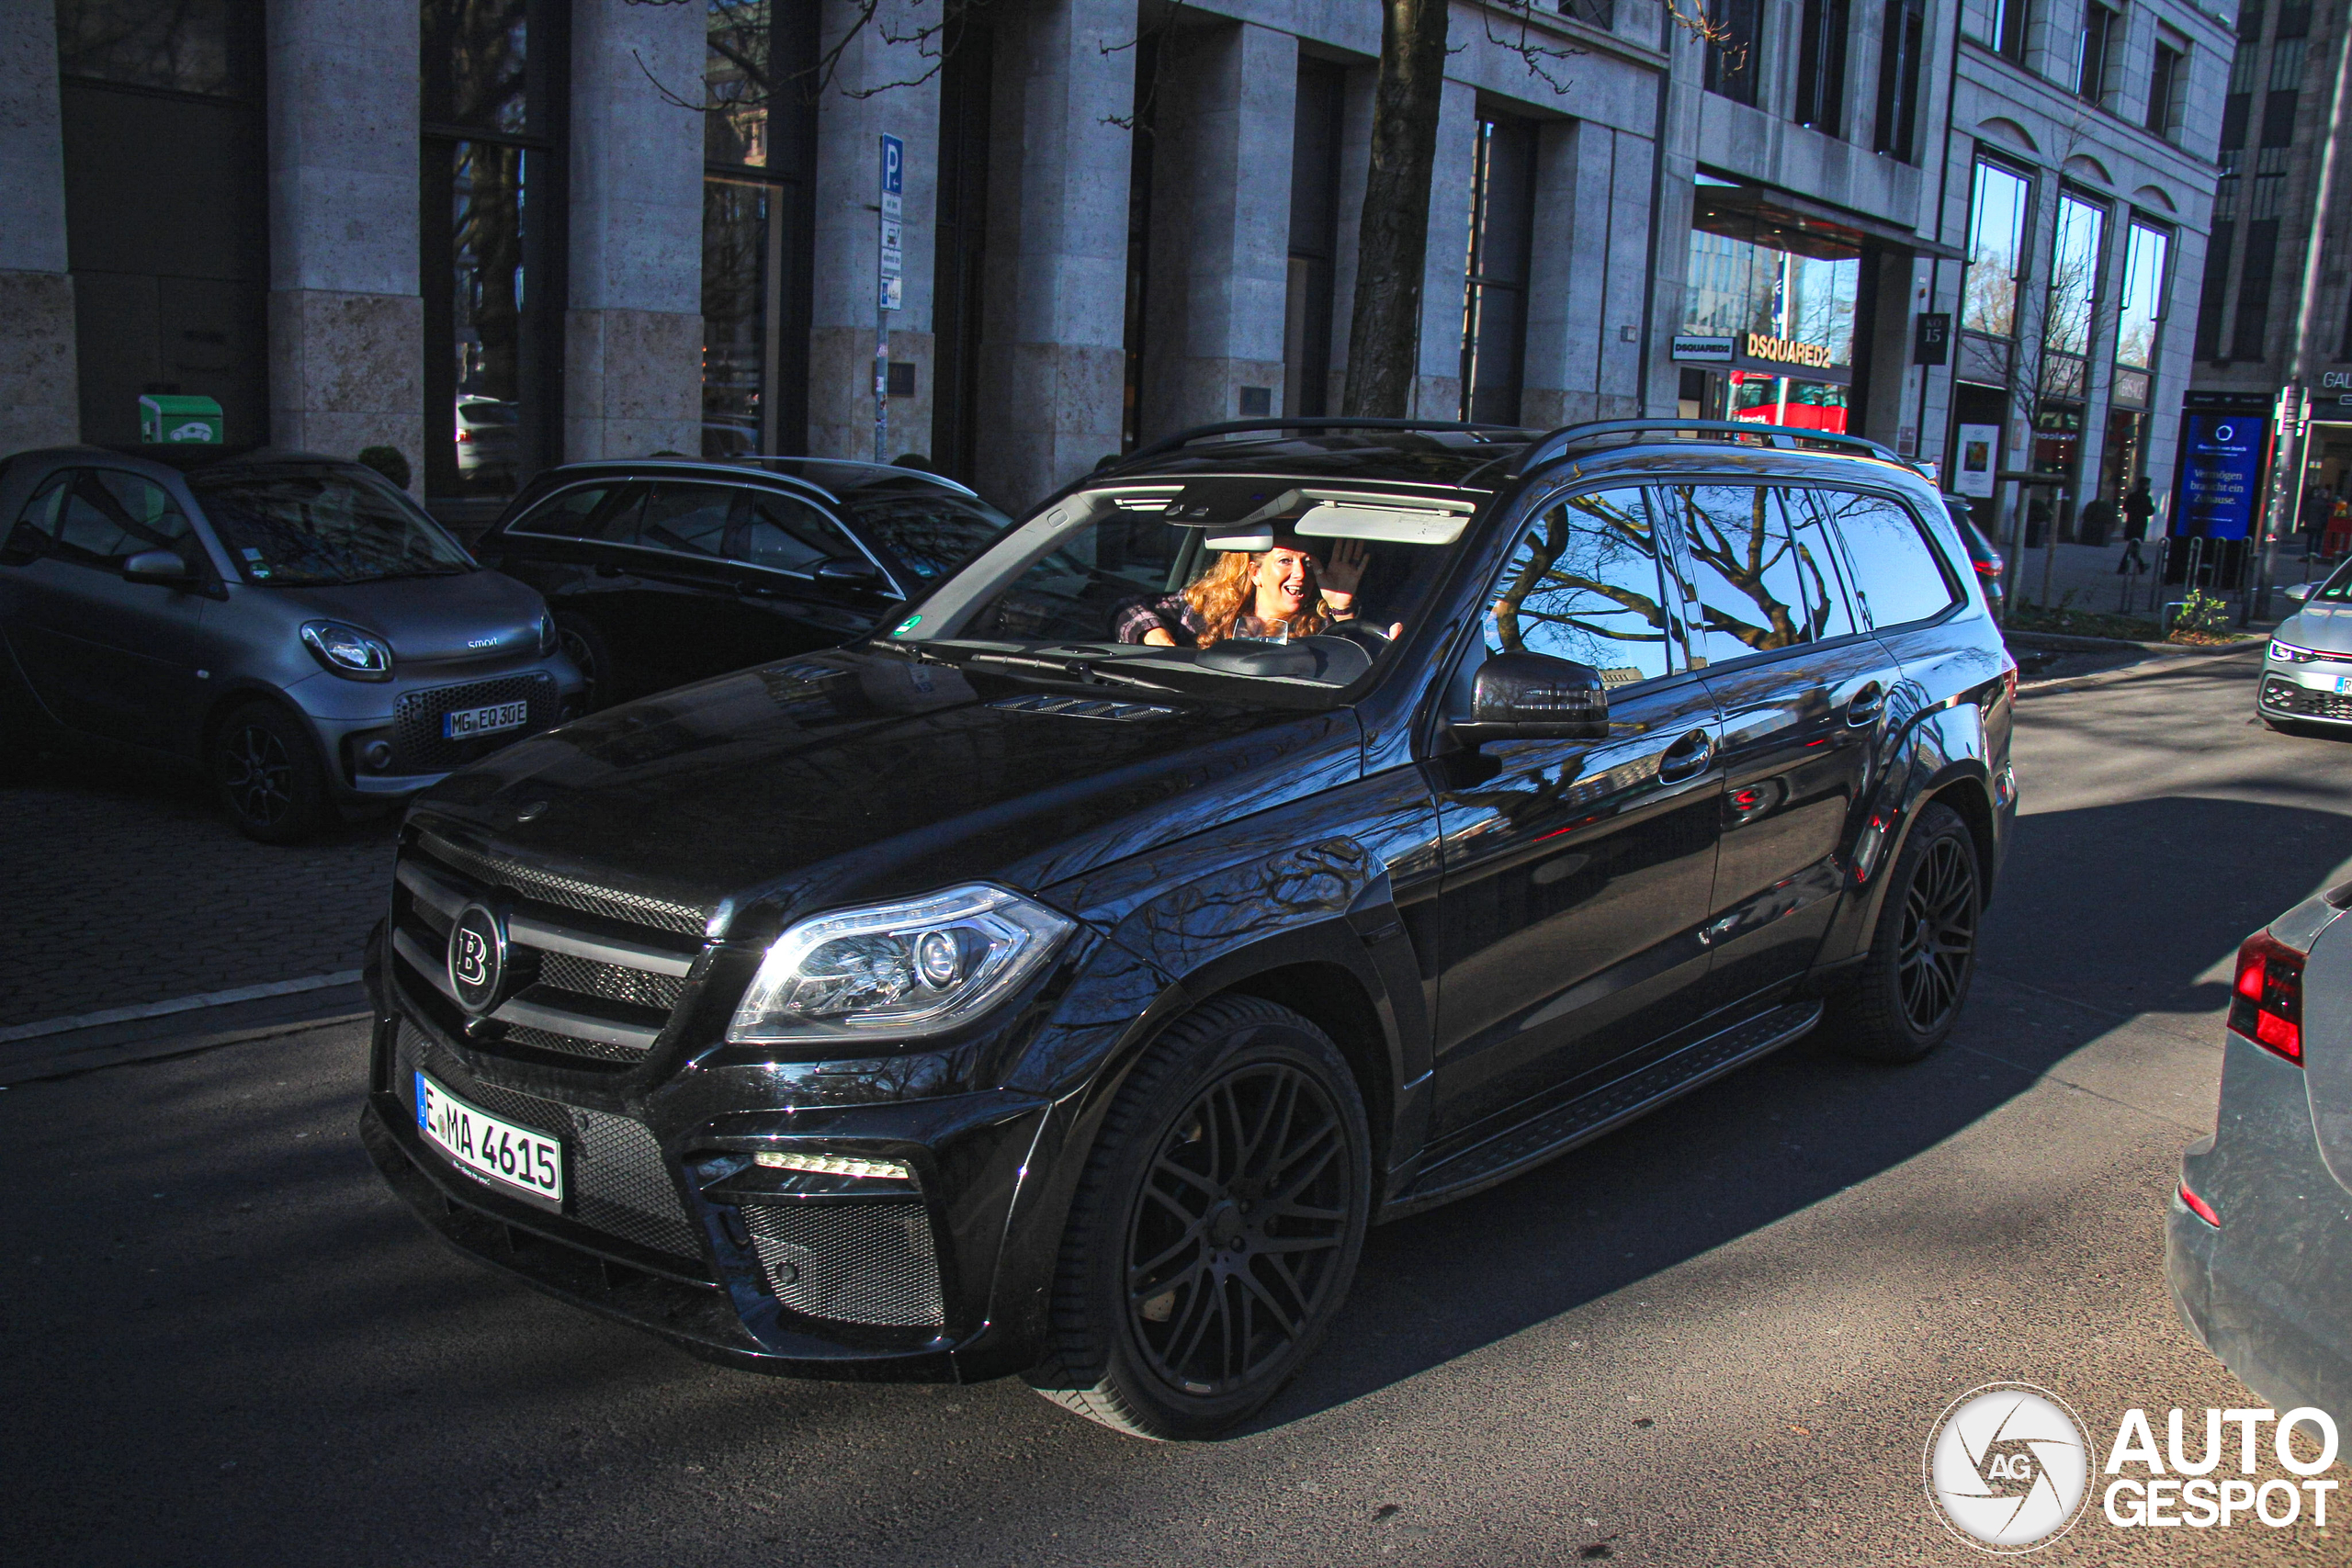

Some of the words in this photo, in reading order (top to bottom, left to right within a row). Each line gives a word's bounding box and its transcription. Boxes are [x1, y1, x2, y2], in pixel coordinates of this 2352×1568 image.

[887, 143, 899, 189] P
[1675, 343, 1730, 354] DSQUARED2
[1925, 329, 1940, 343] 15
[1747, 333, 1831, 368] DSQUARED2
[2195, 469, 2243, 481] Vermögen
[2228, 484, 2244, 492] ein
[452, 712, 470, 734] MG
[479, 708, 497, 728] EQ
[458, 928, 487, 986] B
[426, 1087, 436, 1133] E
[447, 1102, 474, 1159] MA
[481, 1125, 556, 1190] 4615
